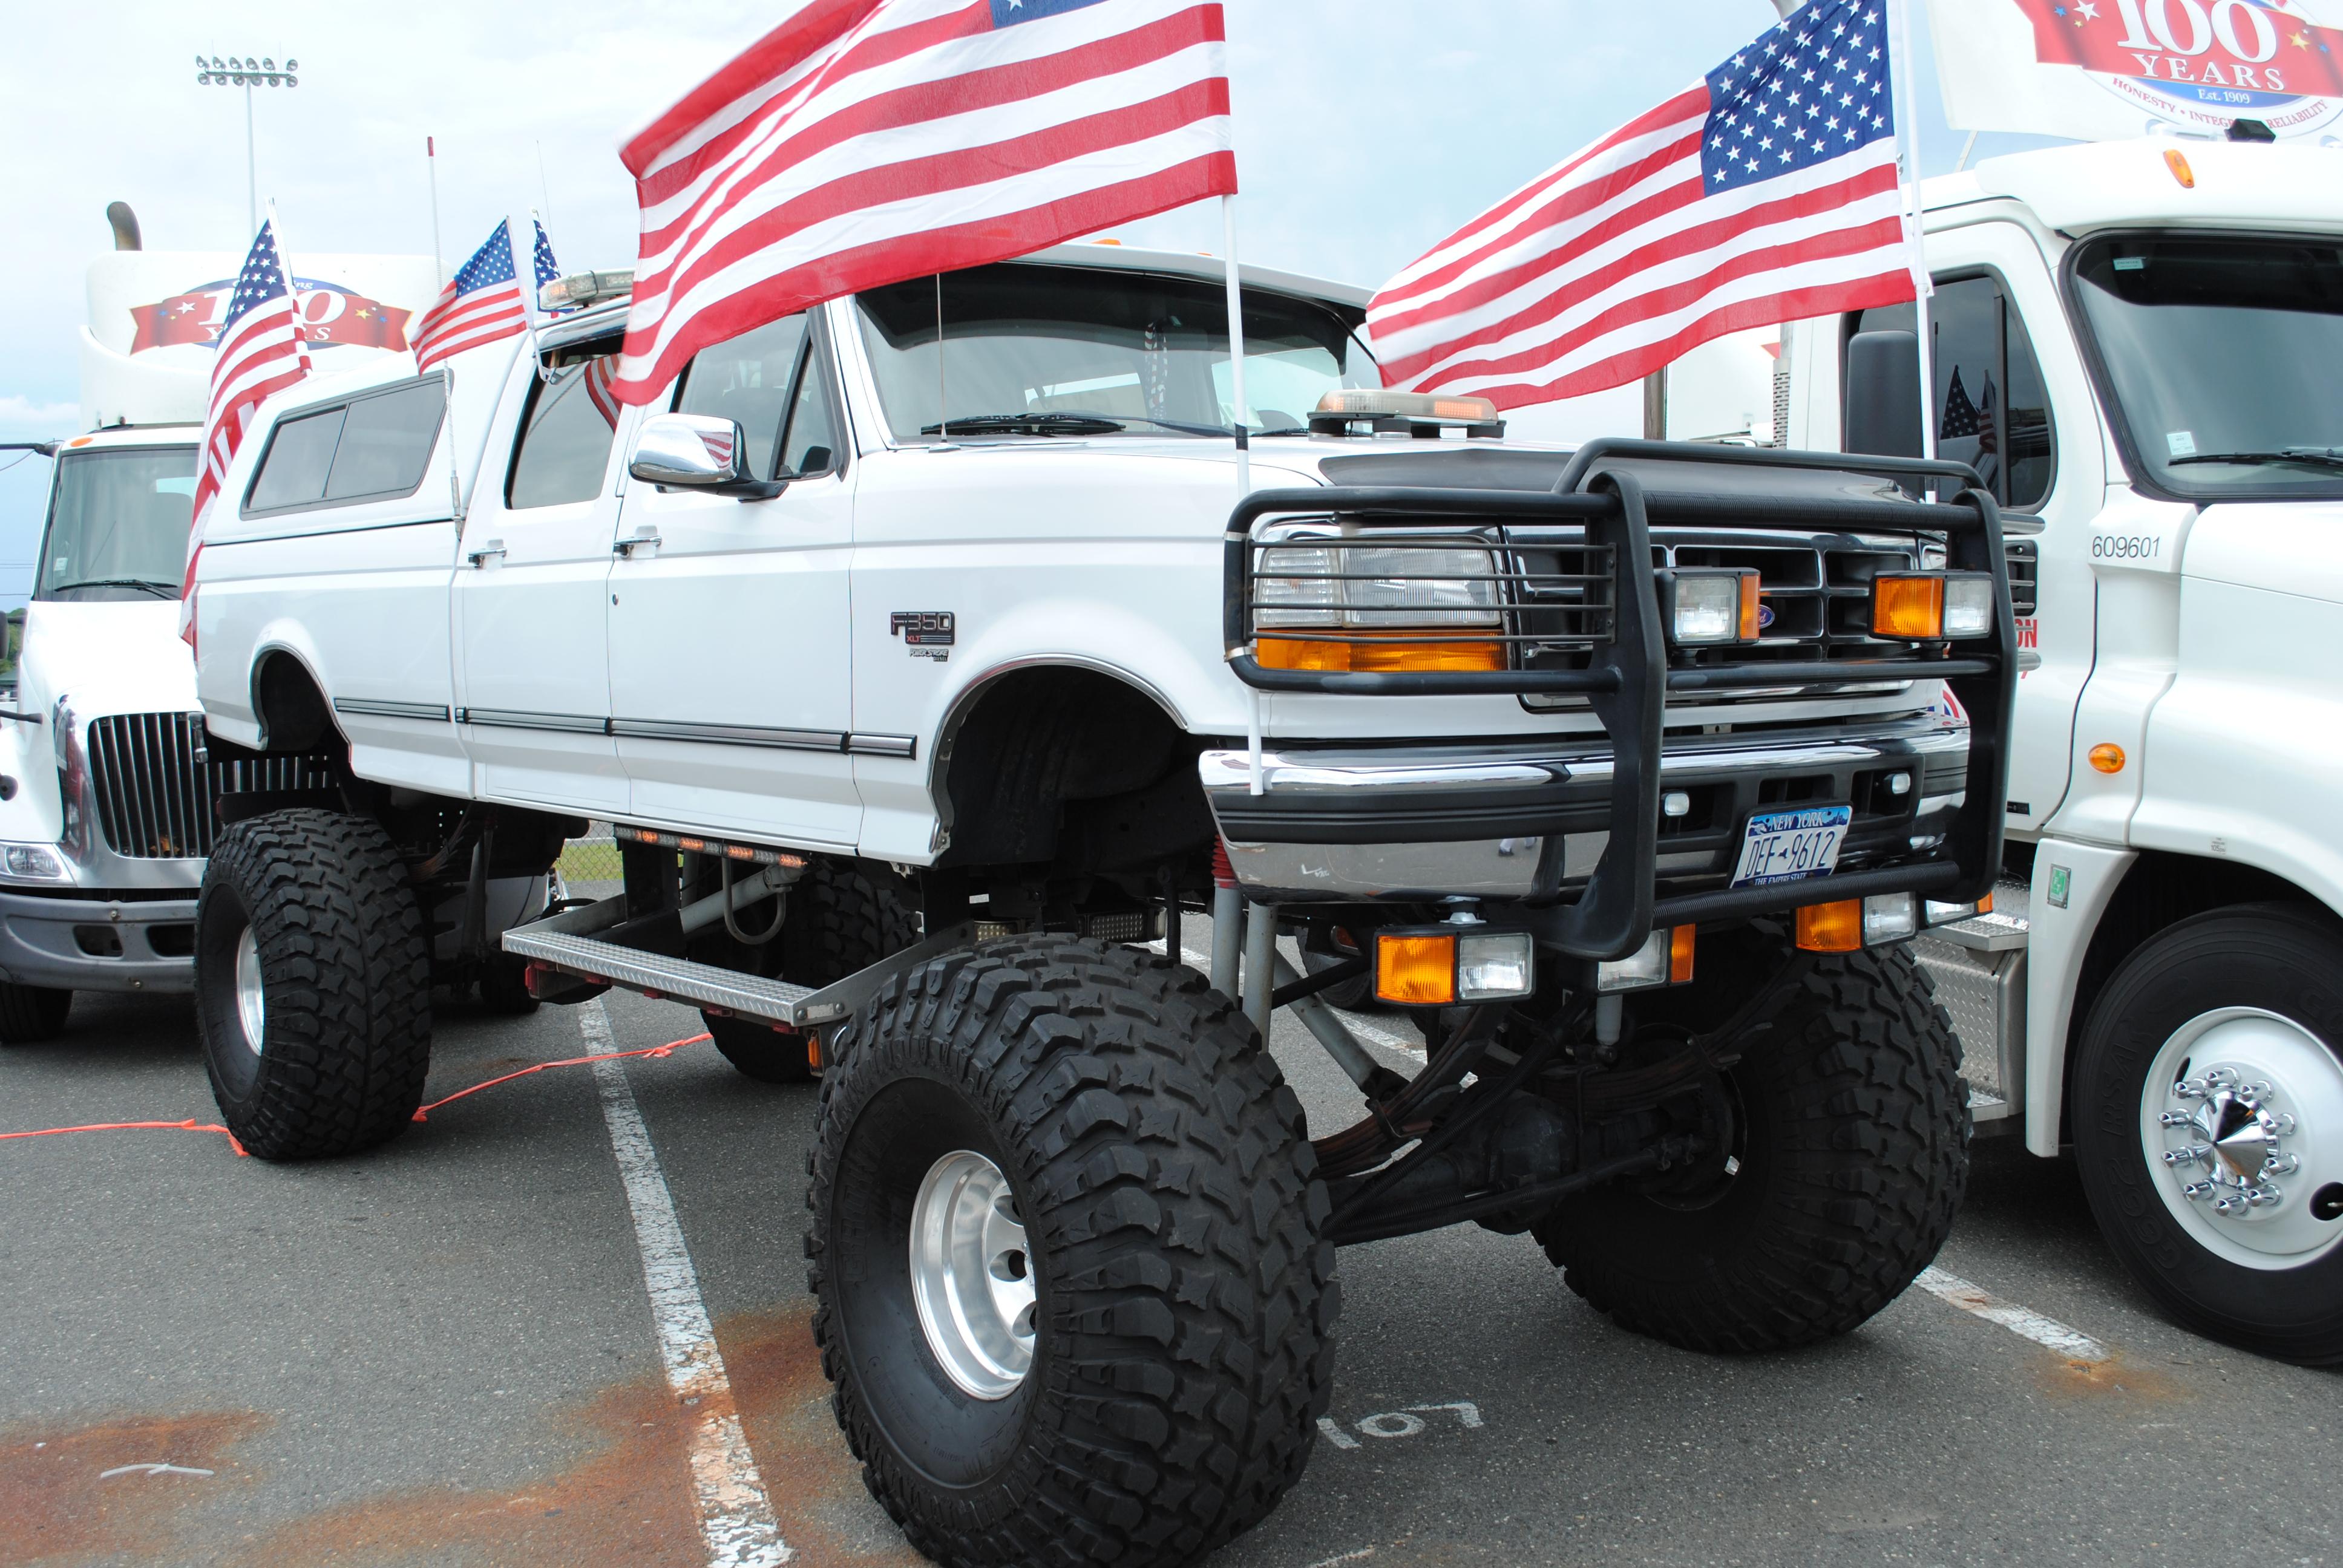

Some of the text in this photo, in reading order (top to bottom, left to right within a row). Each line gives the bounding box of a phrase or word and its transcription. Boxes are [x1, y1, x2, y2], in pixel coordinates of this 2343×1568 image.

[2117, 0, 2276, 63] 100
[2131, 53, 2286, 91] YEARS
[2112, 77, 2176, 113] HONESTY
[2266, 99, 2328, 129] RELIABILITY
[2198, 89, 2250, 104] Est. 1909
[2092, 535, 2160, 558] 609601
[1769, 811, 1826, 832] NEW YORK
[1755, 872, 1808, 886] THE EMPIRE STATE
